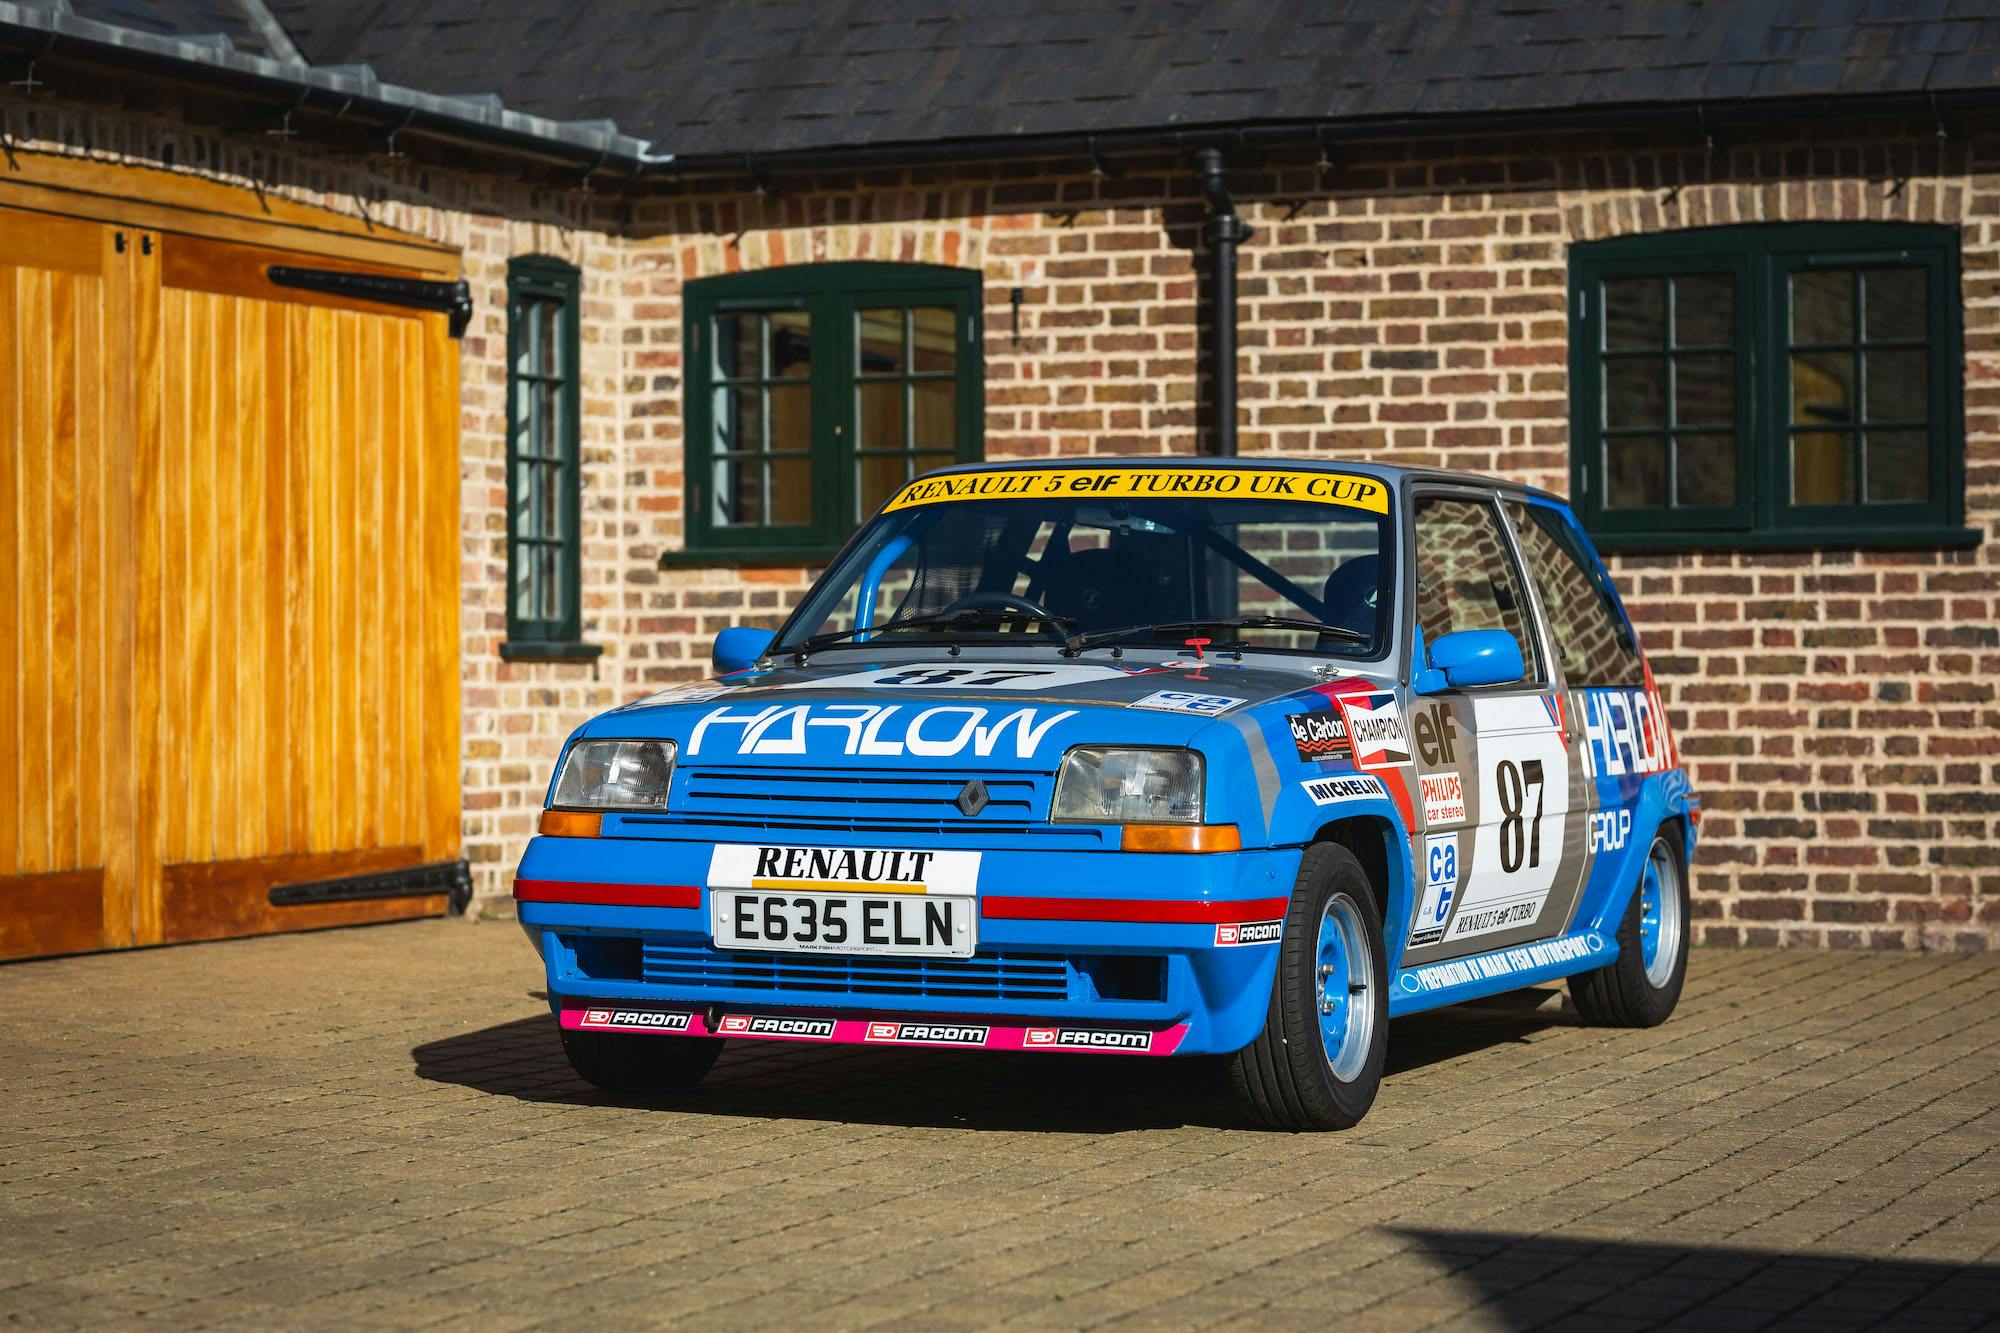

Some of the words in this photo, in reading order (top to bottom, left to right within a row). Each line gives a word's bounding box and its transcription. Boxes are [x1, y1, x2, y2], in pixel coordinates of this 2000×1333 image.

[899, 475, 1041, 505] RENAULT
[1047, 474, 1063, 492] 5
[1070, 474, 1122, 491] elf
[1129, 474, 1242, 493] TURBO
[1250, 476, 1299, 495] UK
[1304, 478, 1378, 504] CUP
[873, 669, 1056, 685] 87
[687, 705, 1079, 759] HARLOW
[1290, 717, 1308, 742] de
[1306, 716, 1347, 742] Carbon
[1352, 717, 1404, 743] CHAMPION
[1414, 703, 1457, 767] elf
[1578, 691, 1673, 777] HARLOW
[1309, 779, 1383, 800] MICHELIN
[1421, 776, 1462, 803] PHILIPS
[1427, 808, 1440, 821] car
[1441, 805, 1464, 819] stereo
[1496, 759, 1544, 873] 87
[1588, 809, 1631, 854] GROUP
[753, 847, 934, 883] RENAULT
[734, 895, 848, 943] E635
[862, 900, 953, 946] ELN
[1456, 911, 1493, 934] RENAULT
[1490, 909, 1499, 927] 5
[1496, 907, 1511, 926] elf
[1508, 901, 1537, 923] TURBO
[1240, 924, 1281, 941] FACOM
[1466, 957, 1483, 980] BY
[1478, 950, 1513, 978] MARK
[1508, 947, 1535, 972] FISH
[1531, 935, 1591, 967] MOTORSPORT
[612, 1012, 687, 1027] FACOM
[751, 1019, 831, 1035] FACOM
[900, 1026, 985, 1042] FACOM
[1059, 1031, 1149, 1047] FACOM
